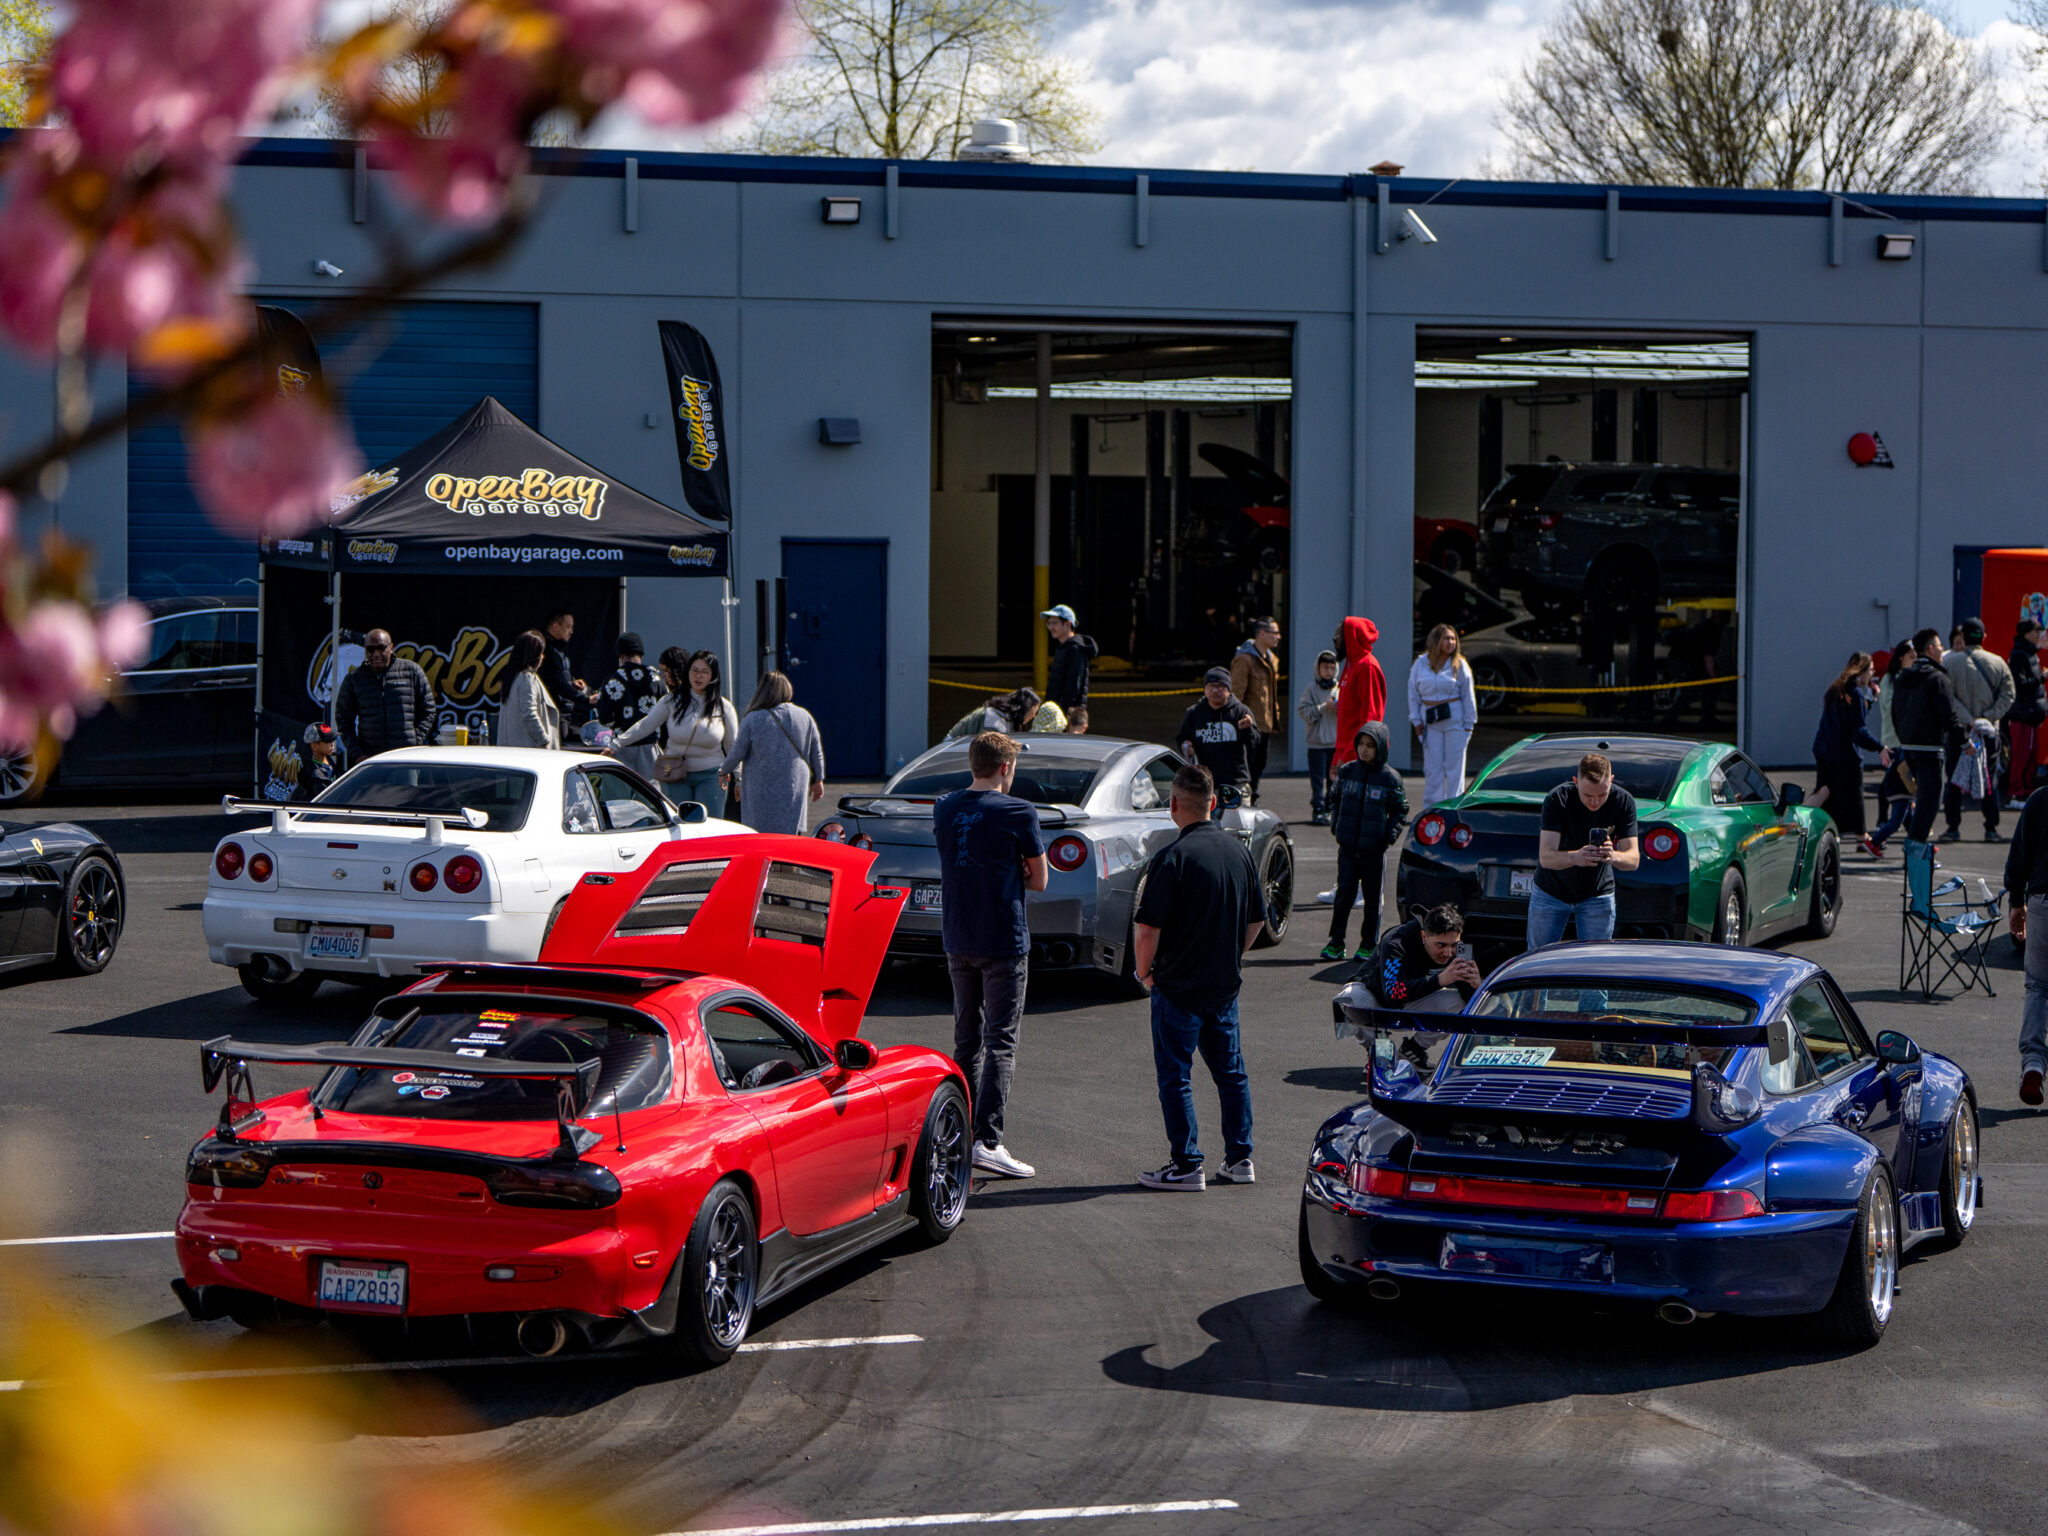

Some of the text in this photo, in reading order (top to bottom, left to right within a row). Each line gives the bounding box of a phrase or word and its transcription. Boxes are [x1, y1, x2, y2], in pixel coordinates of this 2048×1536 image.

[679, 375, 718, 470] OpenBay
[701, 392, 718, 450] garage
[426, 468, 608, 520] OpenBay
[467, 503, 580, 516] garage
[348, 540, 398, 562] OpenBay
[445, 544, 624, 563] openbaygarage.com
[1195, 729, 1222, 738] NORTH
[1206, 722, 1222, 730] THE
[310, 935, 360, 953] CMU4006
[1469, 1053, 1545, 1065] BWW7947
[326, 1268, 374, 1277] WASHINGTON
[323, 1277, 400, 1305] CAP2893
